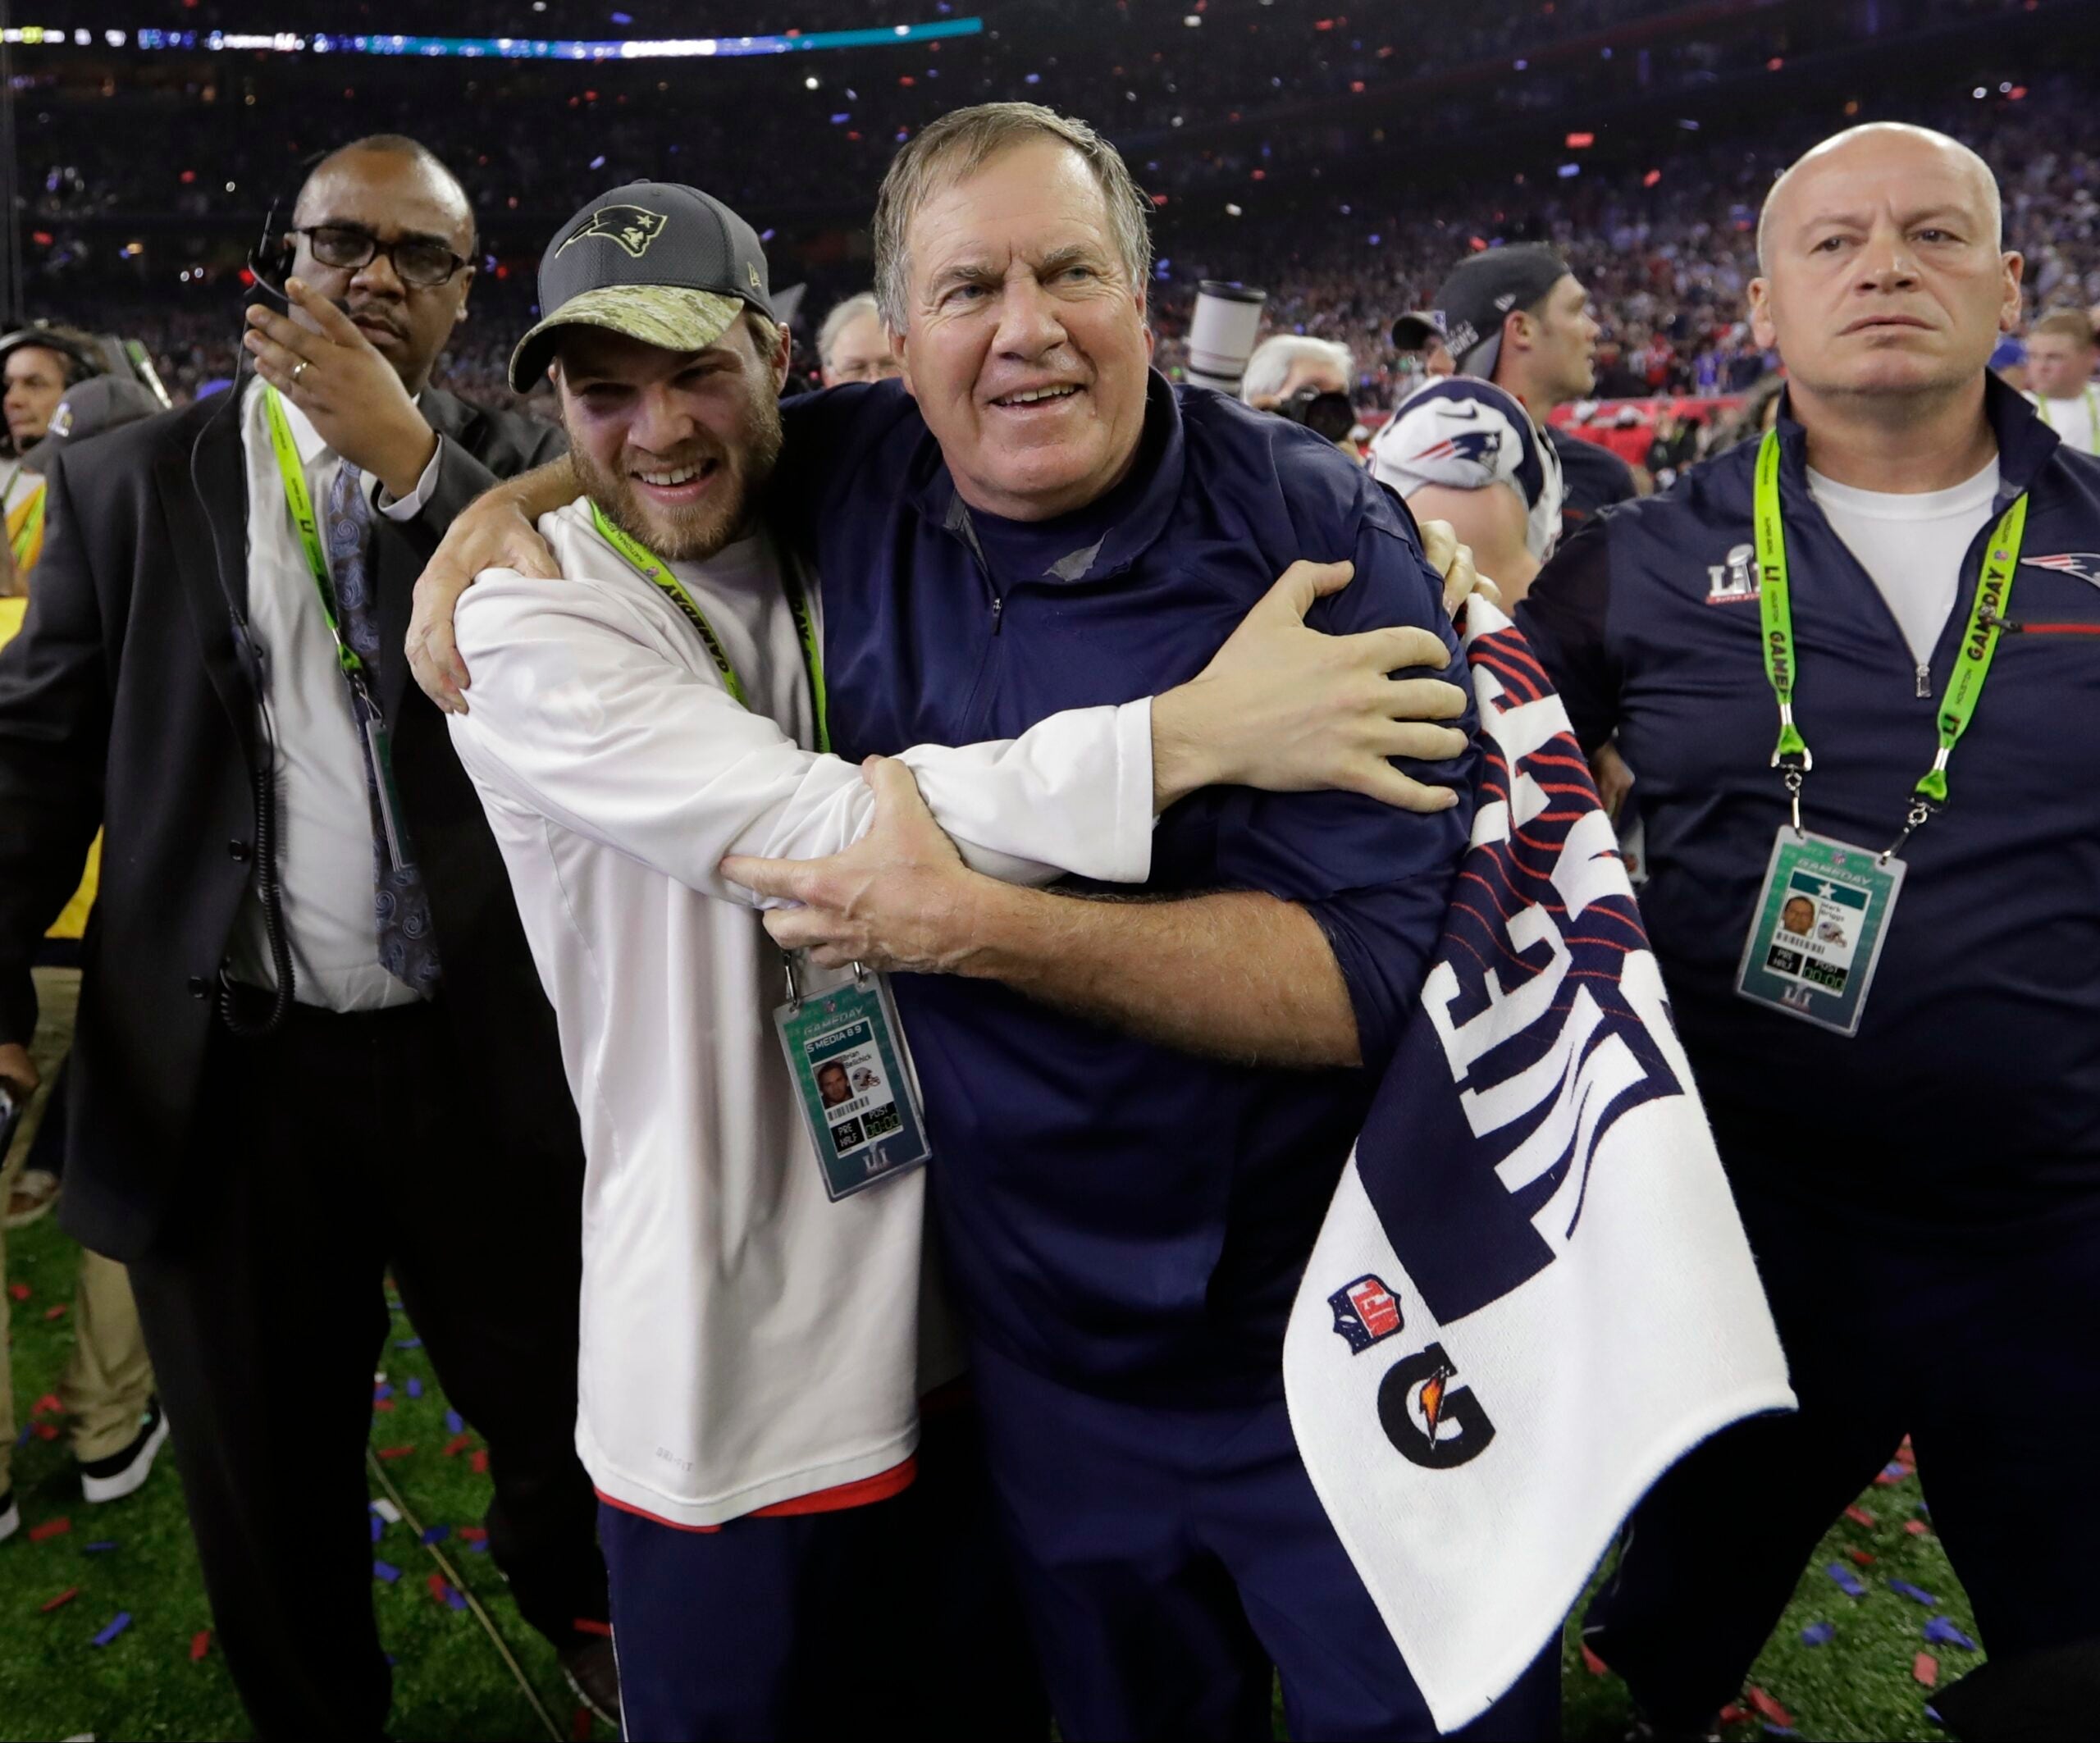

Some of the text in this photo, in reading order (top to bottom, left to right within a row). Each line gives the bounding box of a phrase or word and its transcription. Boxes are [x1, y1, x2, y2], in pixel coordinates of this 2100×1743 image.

[616, 528, 645, 563] NATIONAL
[1764, 566, 1780, 582] LI
[1942, 713, 1961, 736] LI
[1967, 568, 2005, 661] GAMDAY
[804, 1007, 864, 1037] GAMEDAY
[815, 1032, 847, 1050] MEDIA
[841, 1051, 860, 1063] Brian
[838, 1124, 854, 1136] PRE
[1377, 1341, 1496, 1469] G
